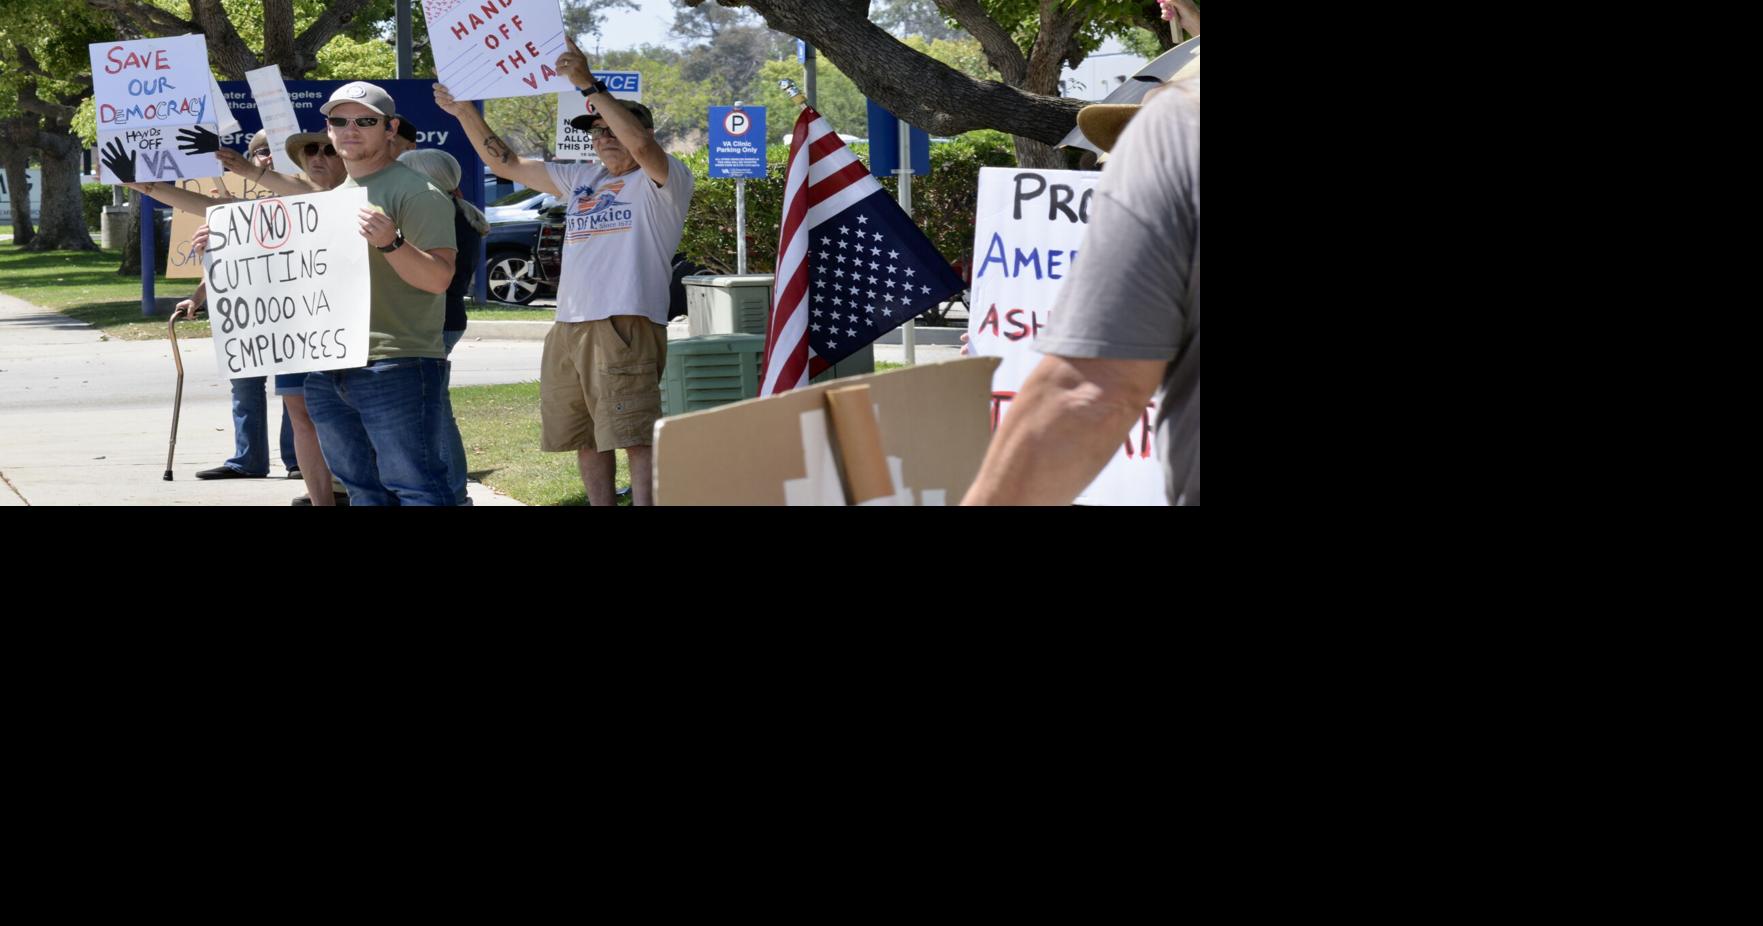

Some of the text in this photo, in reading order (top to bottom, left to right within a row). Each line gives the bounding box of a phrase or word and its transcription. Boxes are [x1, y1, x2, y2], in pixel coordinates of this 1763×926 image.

[485, 15, 522, 49] OFF
[105, 46, 171, 74] SAVE
[496, 41, 539, 74] THE
[128, 77, 175, 96] OUR
[522, 64, 556, 89] VA
[594, 76, 637, 90] TICE
[223, 91, 246, 99] ater
[101, 95, 206, 124] DEMOCRACY
[732, 115, 744, 131] P
[139, 138, 163, 149] OFF
[141, 151, 184, 178] VA
[206, 201, 318, 252] SAY NO TO
[209, 249, 327, 294] CUTTING
[216, 289, 331, 333] 80,000 VA
[224, 328, 347, 373] EMPLOYEES
